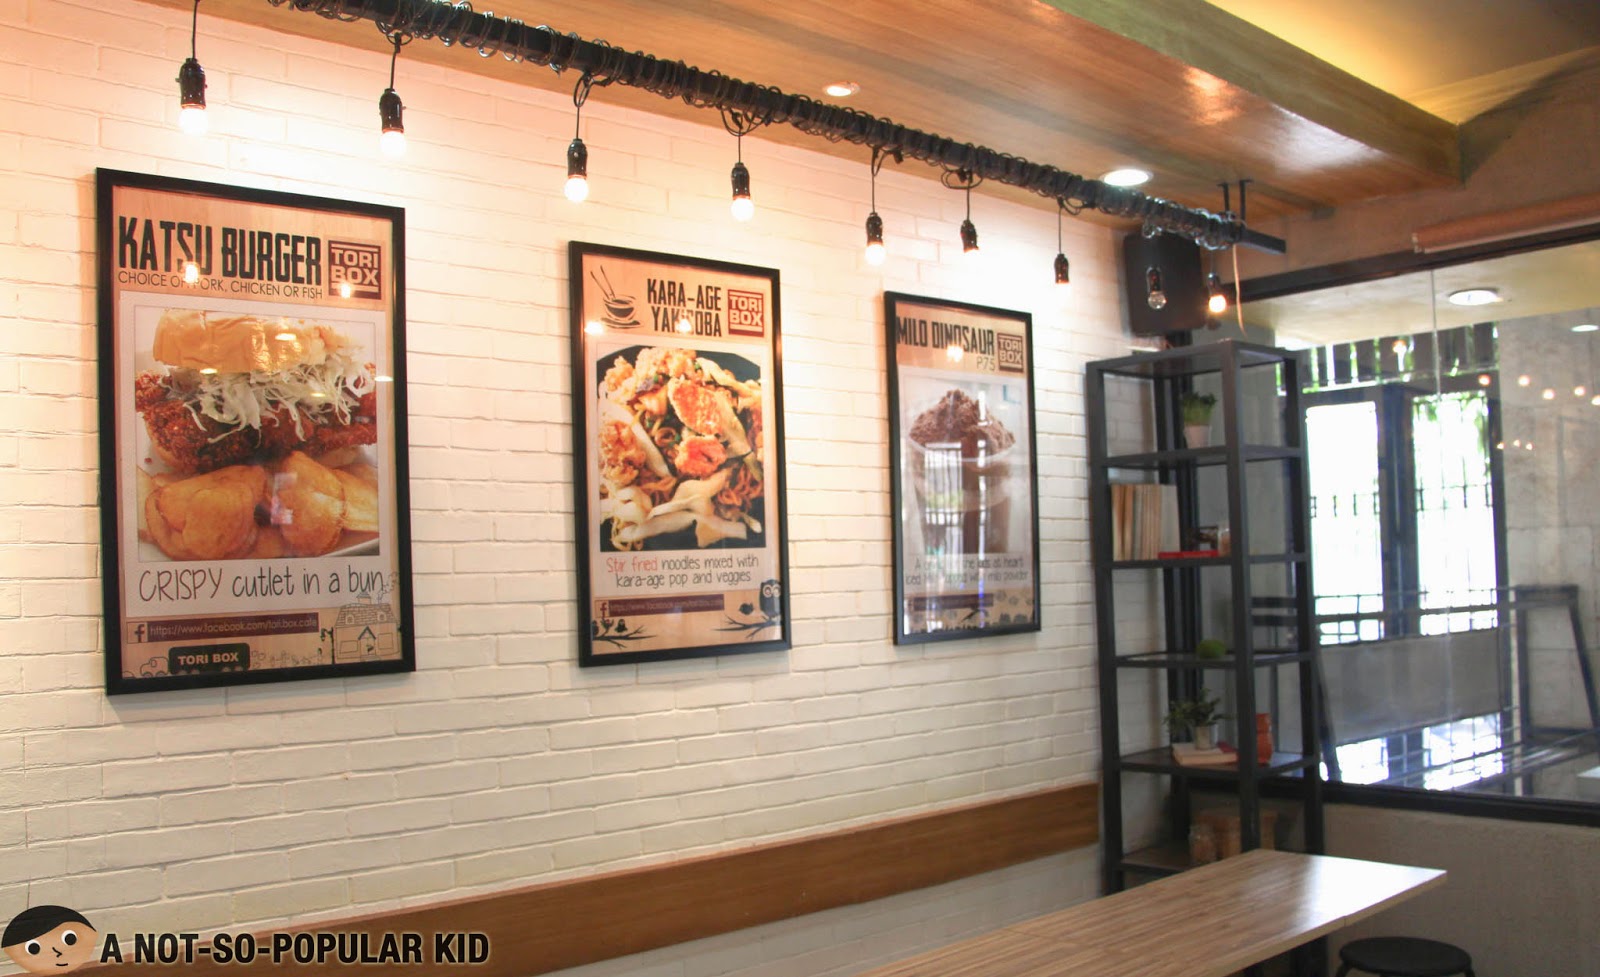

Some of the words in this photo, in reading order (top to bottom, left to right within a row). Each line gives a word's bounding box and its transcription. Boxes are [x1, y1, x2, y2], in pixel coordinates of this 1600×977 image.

[118, 215, 213, 275] KATSU
[221, 227, 322, 286] BURGER
[331, 248, 379, 269] TORI
[118, 271, 166, 286] CHOICE
[231, 280, 280, 295] CHICKEN
[283, 285, 299, 298] OR
[303, 287, 323, 299] FISH
[331, 265, 379, 286] BOX
[647, 278, 721, 311] KARA-AGE
[730, 296, 762, 312] TORI
[730, 309, 762, 326] BOX
[896, 316, 927, 347] MILO
[932, 321, 994, 356] DINOSAUR
[1000, 339, 1022, 351] TORI
[1000, 350, 1023, 363] BOX
[606, 556, 625, 573] Stir
[632, 556, 658, 572] fried
[661, 556, 700, 571] noodles
[704, 555, 733, 569] mixed
[737, 554, 759, 568] with
[139, 568, 223, 601] CRISPY
[232, 566, 294, 598] cutlet
[303, 568, 320, 595] in
[328, 572, 340, 593] a
[348, 565, 383, 593] bun
[616, 573, 664, 589] kara-age
[670, 573, 688, 588] pop
[692, 571, 712, 585] and
[716, 570, 751, 586] veggies
[178, 655, 209, 666] TORI
[212, 652, 239, 664] BOX
